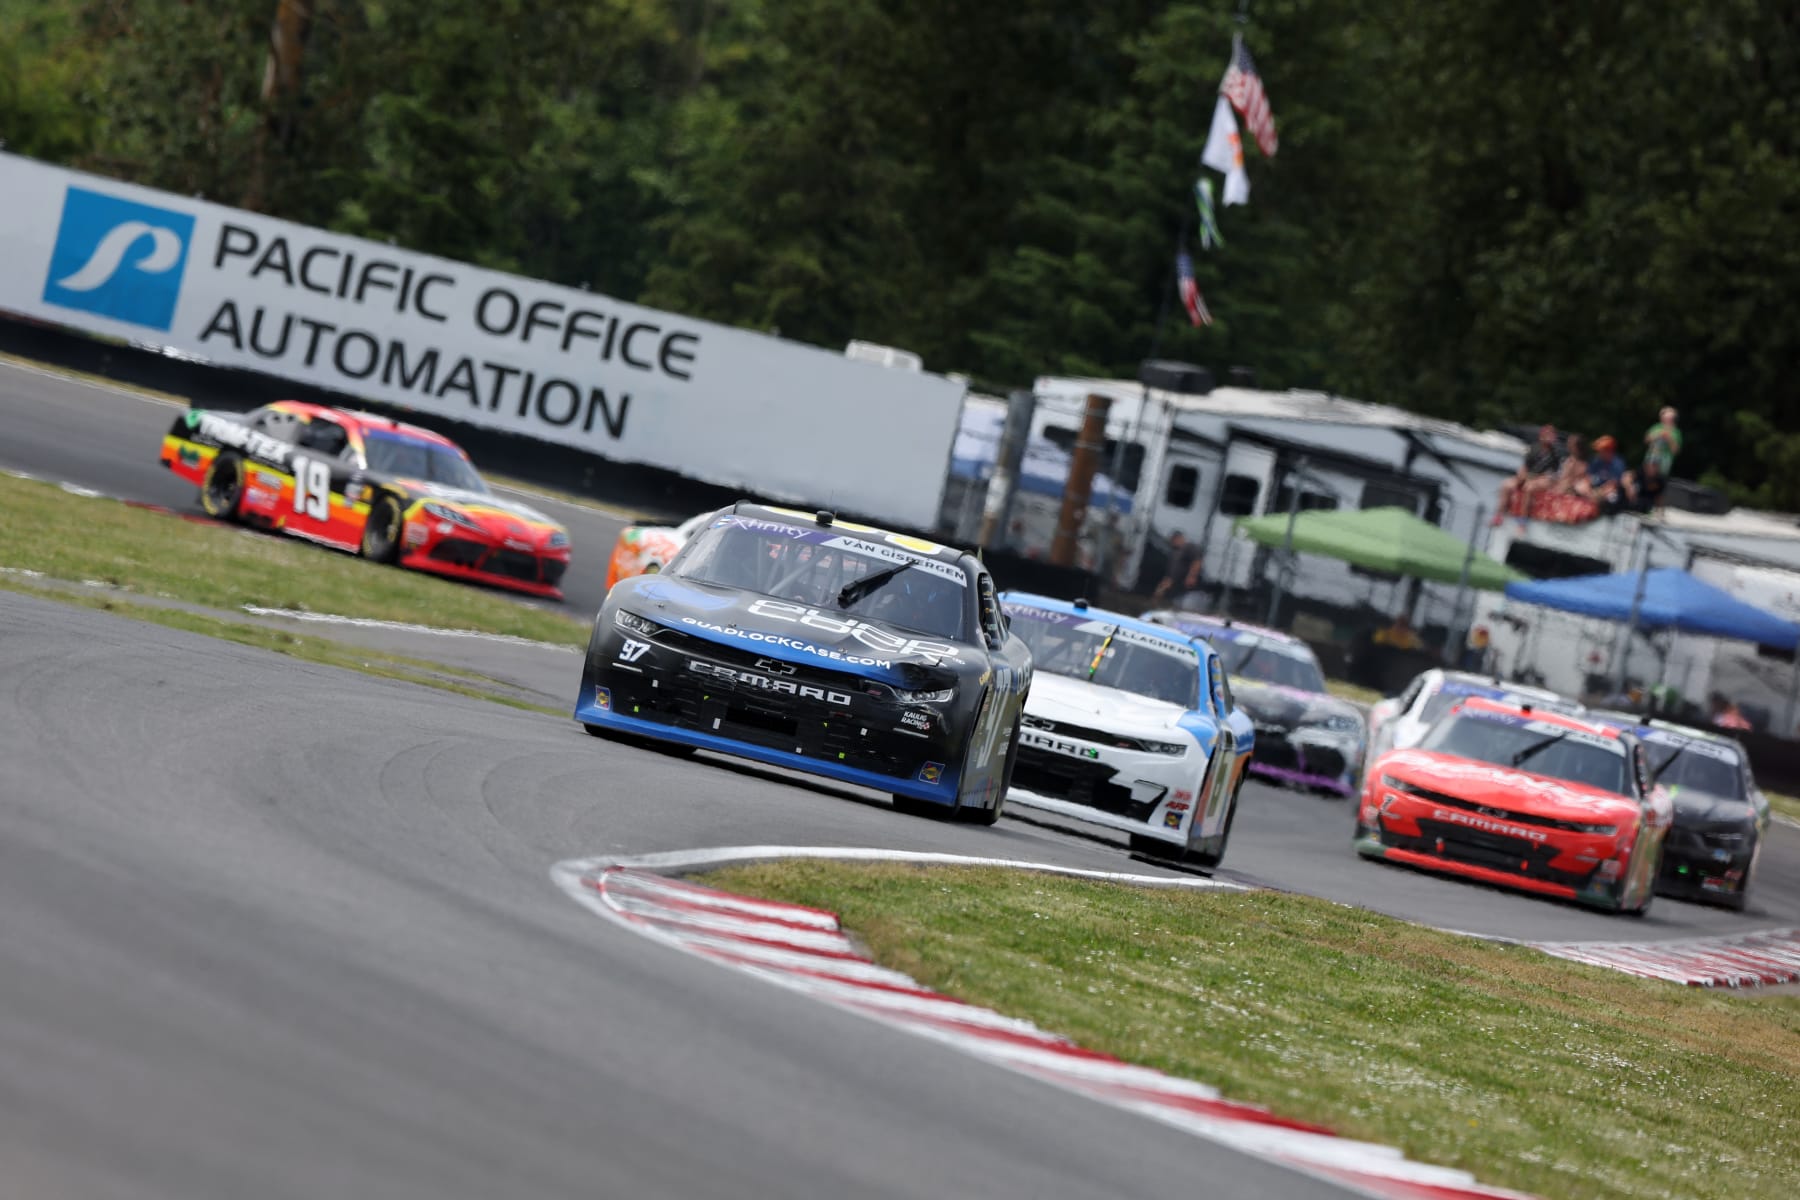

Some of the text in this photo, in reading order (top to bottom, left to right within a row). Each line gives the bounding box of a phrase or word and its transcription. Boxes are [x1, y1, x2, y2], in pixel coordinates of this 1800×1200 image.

[213, 222, 701, 381] PACIFIC OFFICE
[199, 299, 631, 439] AUTOMATION
[293, 456, 330, 522] 19
[843, 538, 875, 553] VAN
[619, 638, 651, 663] 97
[681, 616, 891, 670] QUADLOCKCASE.COM
[688, 659, 852, 706] CAMARO
[1432, 808, 1548, 842] CAMARO
